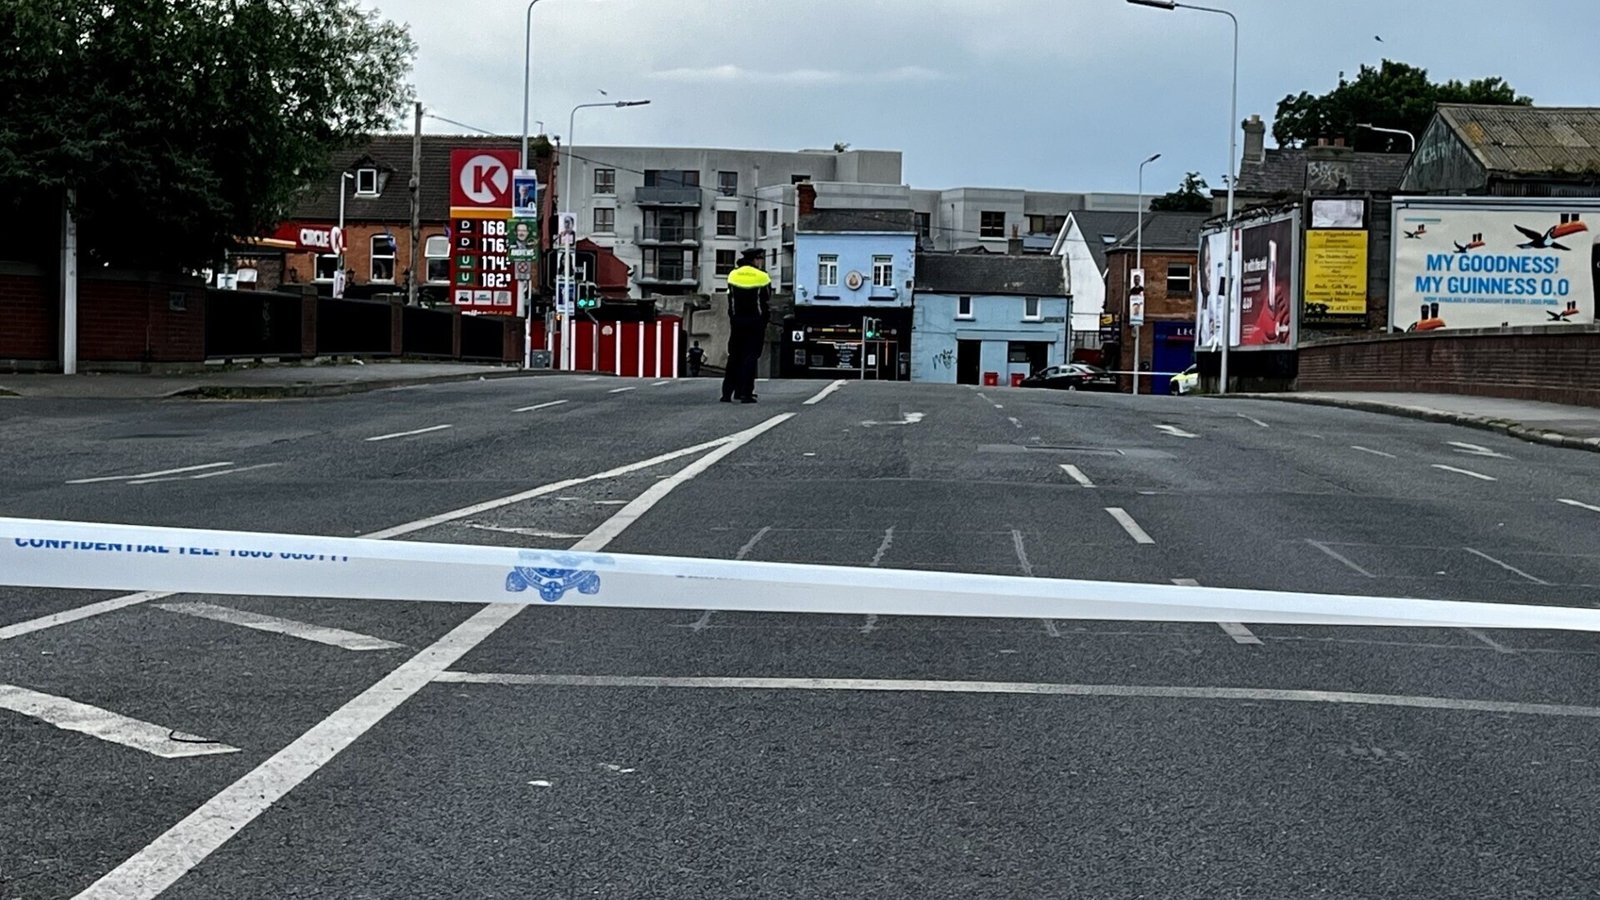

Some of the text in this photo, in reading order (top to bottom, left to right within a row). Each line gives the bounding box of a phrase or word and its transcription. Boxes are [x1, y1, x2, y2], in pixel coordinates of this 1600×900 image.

[472, 164, 505, 201] K
[301, 228, 330, 248] CIRCLE
[482, 220, 509, 236] 168.
[1426, 253, 1560, 274] MY GOODNESS!
[1415, 275, 1569, 296] MY GUINNESS 0.0
